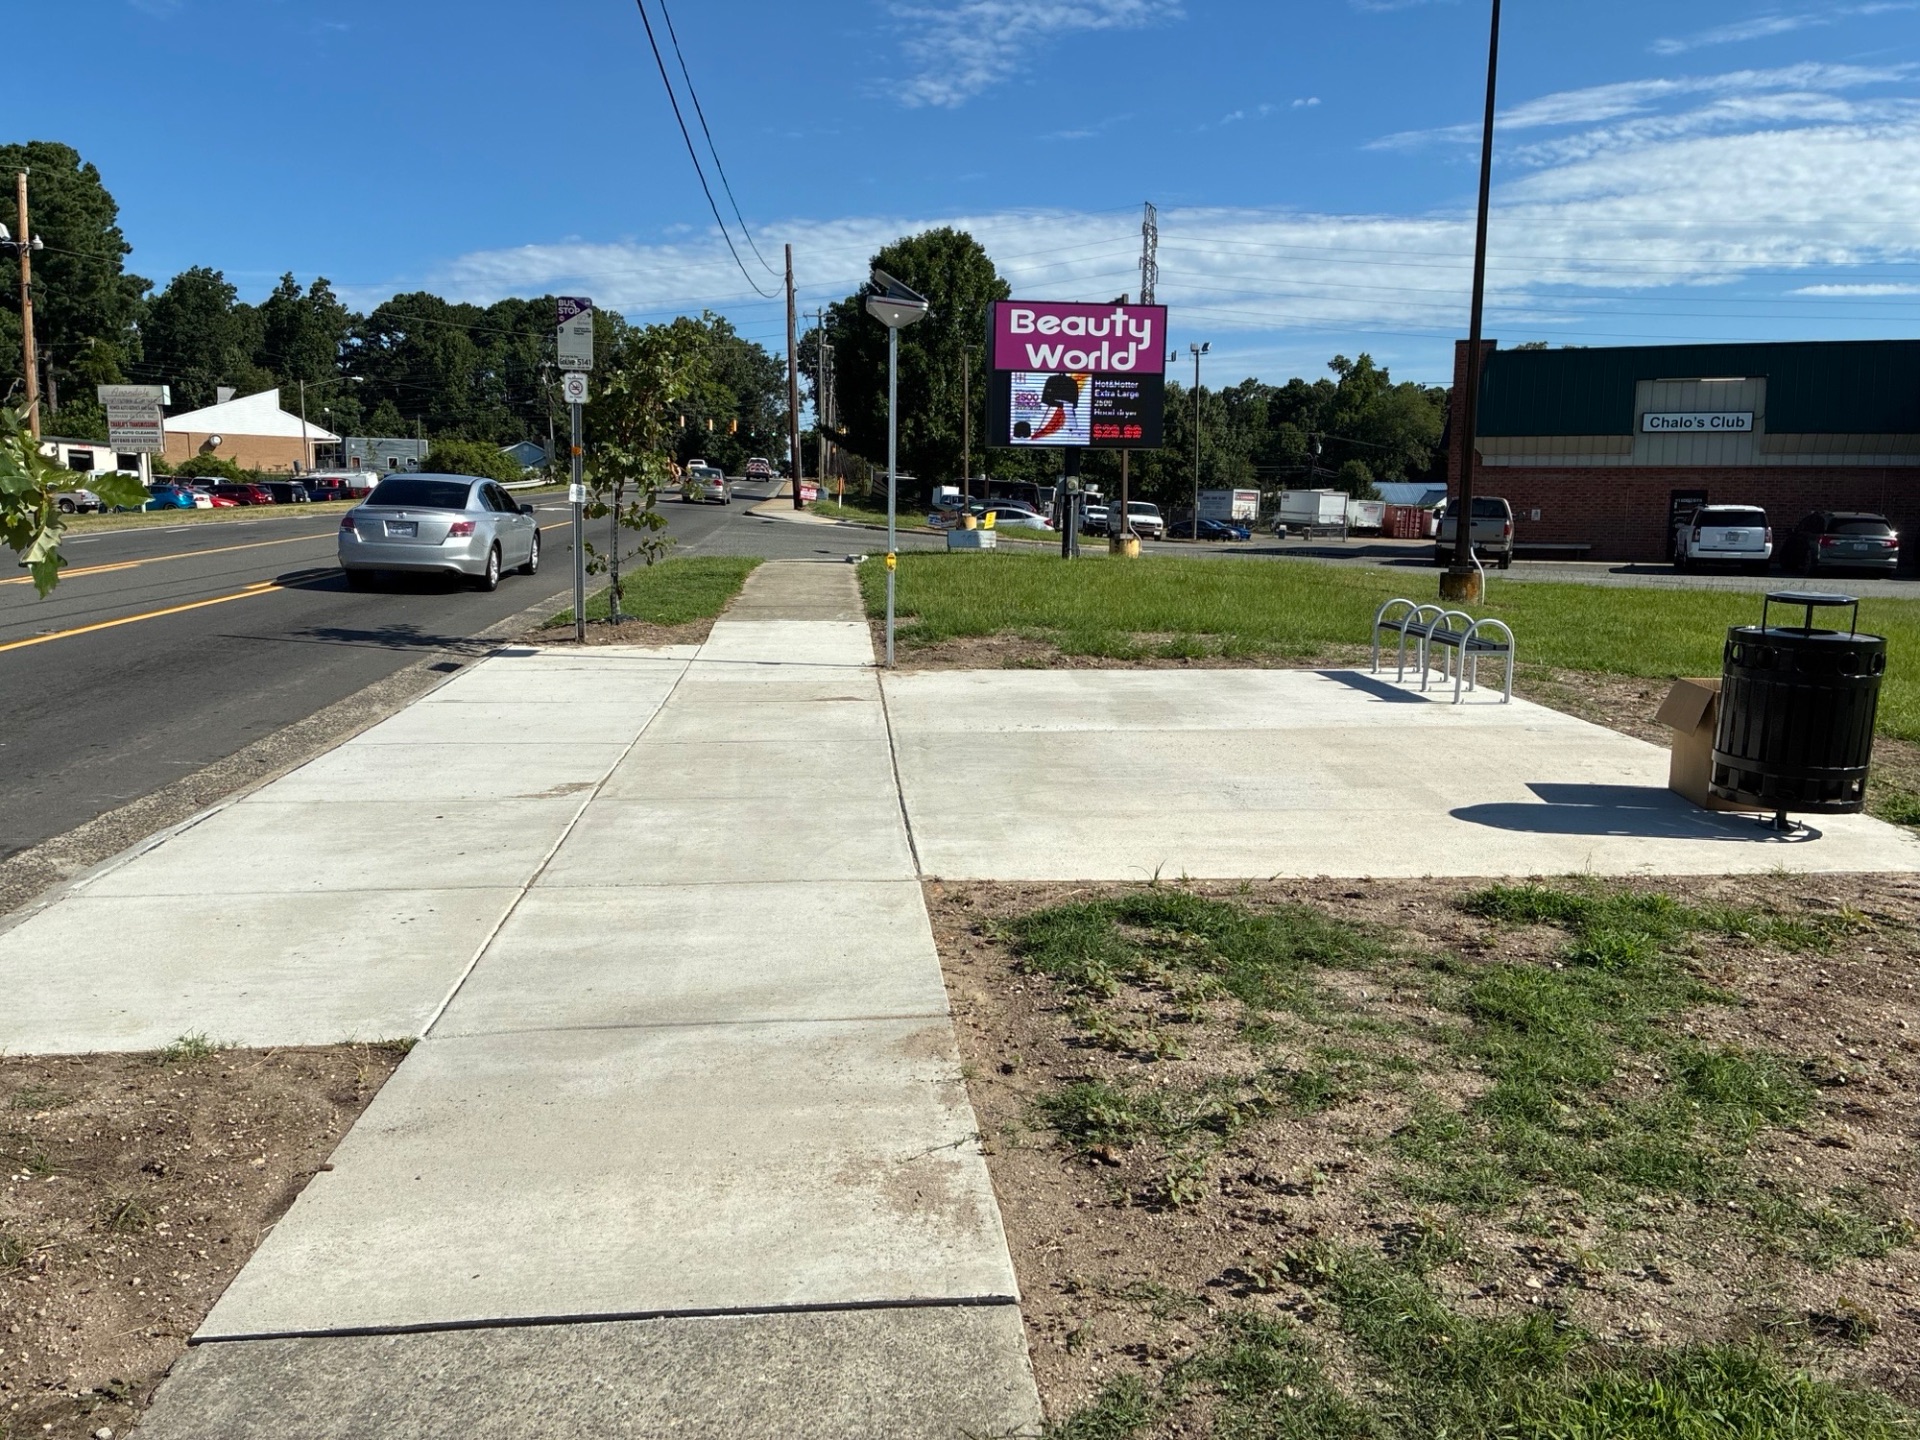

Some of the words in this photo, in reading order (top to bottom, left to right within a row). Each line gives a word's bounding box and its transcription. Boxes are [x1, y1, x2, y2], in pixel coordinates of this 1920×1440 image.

[558, 307, 580, 315] STOP
[559, 326, 564, 334] 9
[1010, 307, 1152, 350] Beauty
[1025, 340, 1137, 371] World
[577, 358, 591, 367] 5141
[1015, 393, 1039, 401] 2500
[1094, 389, 1115, 397] Extra
[1117, 389, 1140, 400] Large
[1650, 416, 1705, 428] Chalo's
[1710, 416, 1745, 428] Club
